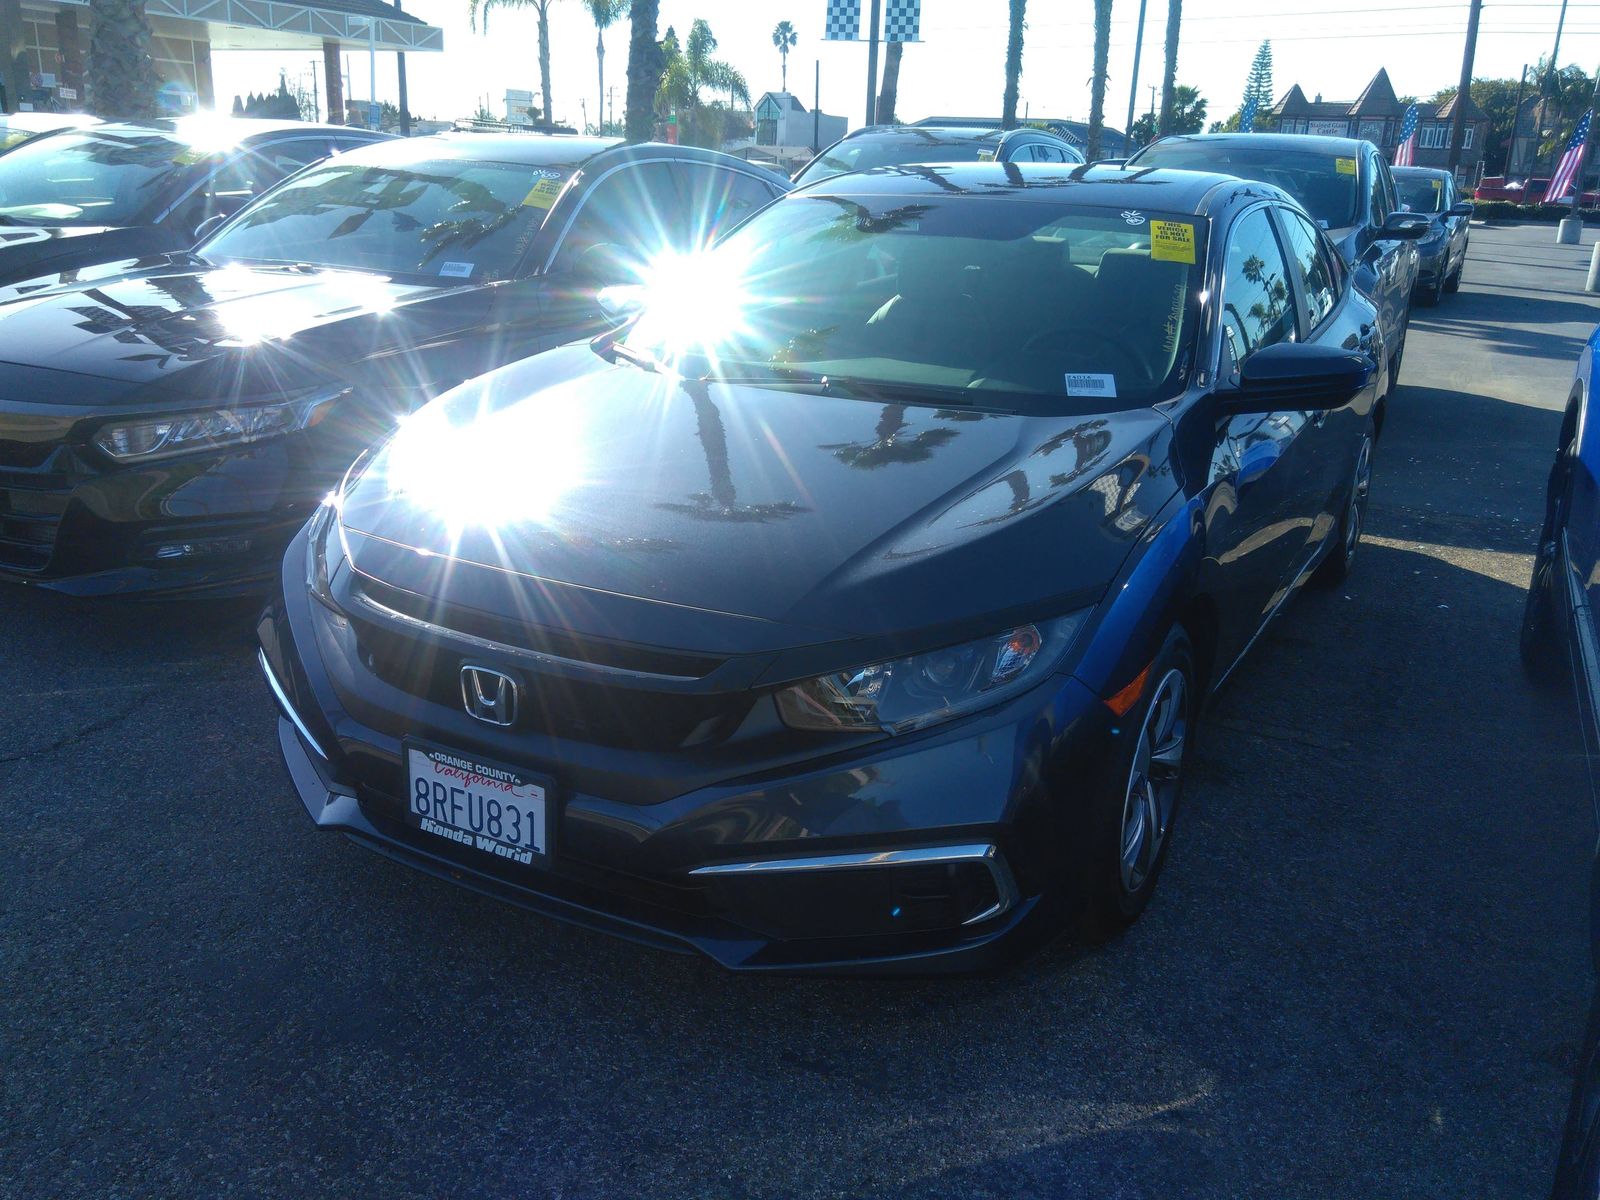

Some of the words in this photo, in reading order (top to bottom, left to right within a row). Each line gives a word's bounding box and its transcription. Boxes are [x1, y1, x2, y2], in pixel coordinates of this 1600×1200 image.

[434, 752, 473, 772] ORANGE
[475, 764, 516, 783] COUNTY
[434, 761, 524, 797] California
[415, 777, 540, 852] 8RFU831
[420, 817, 474, 847] Honda
[475, 836, 533, 865] World
